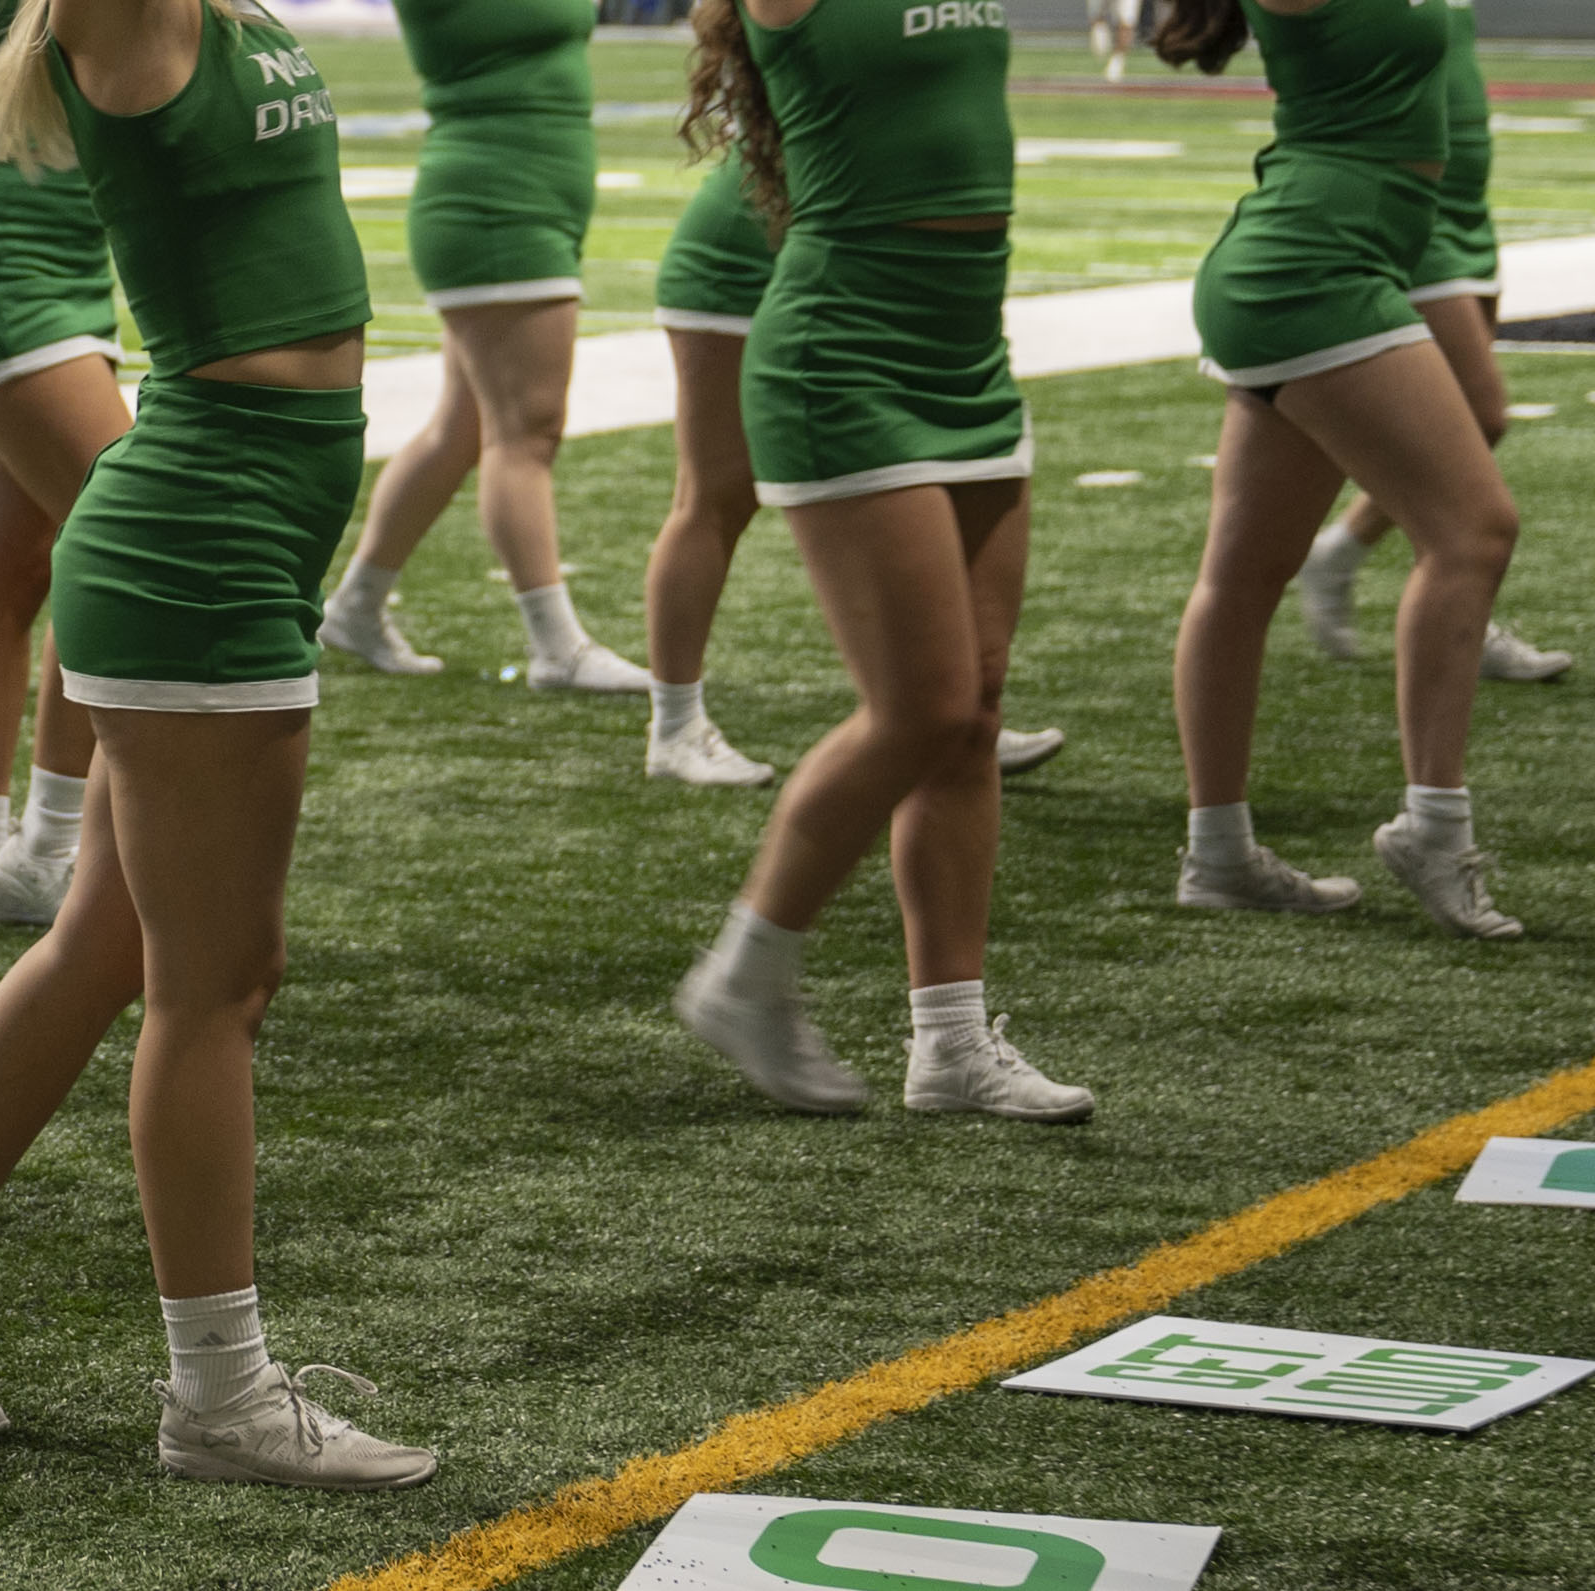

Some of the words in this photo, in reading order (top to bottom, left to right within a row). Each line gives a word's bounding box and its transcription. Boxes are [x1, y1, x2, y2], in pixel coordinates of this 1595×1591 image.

[903, 0, 1007, 38] DAKO
[1085, 1333, 1326, 1390] GET
[1262, 1348, 1543, 1416] LOUD
